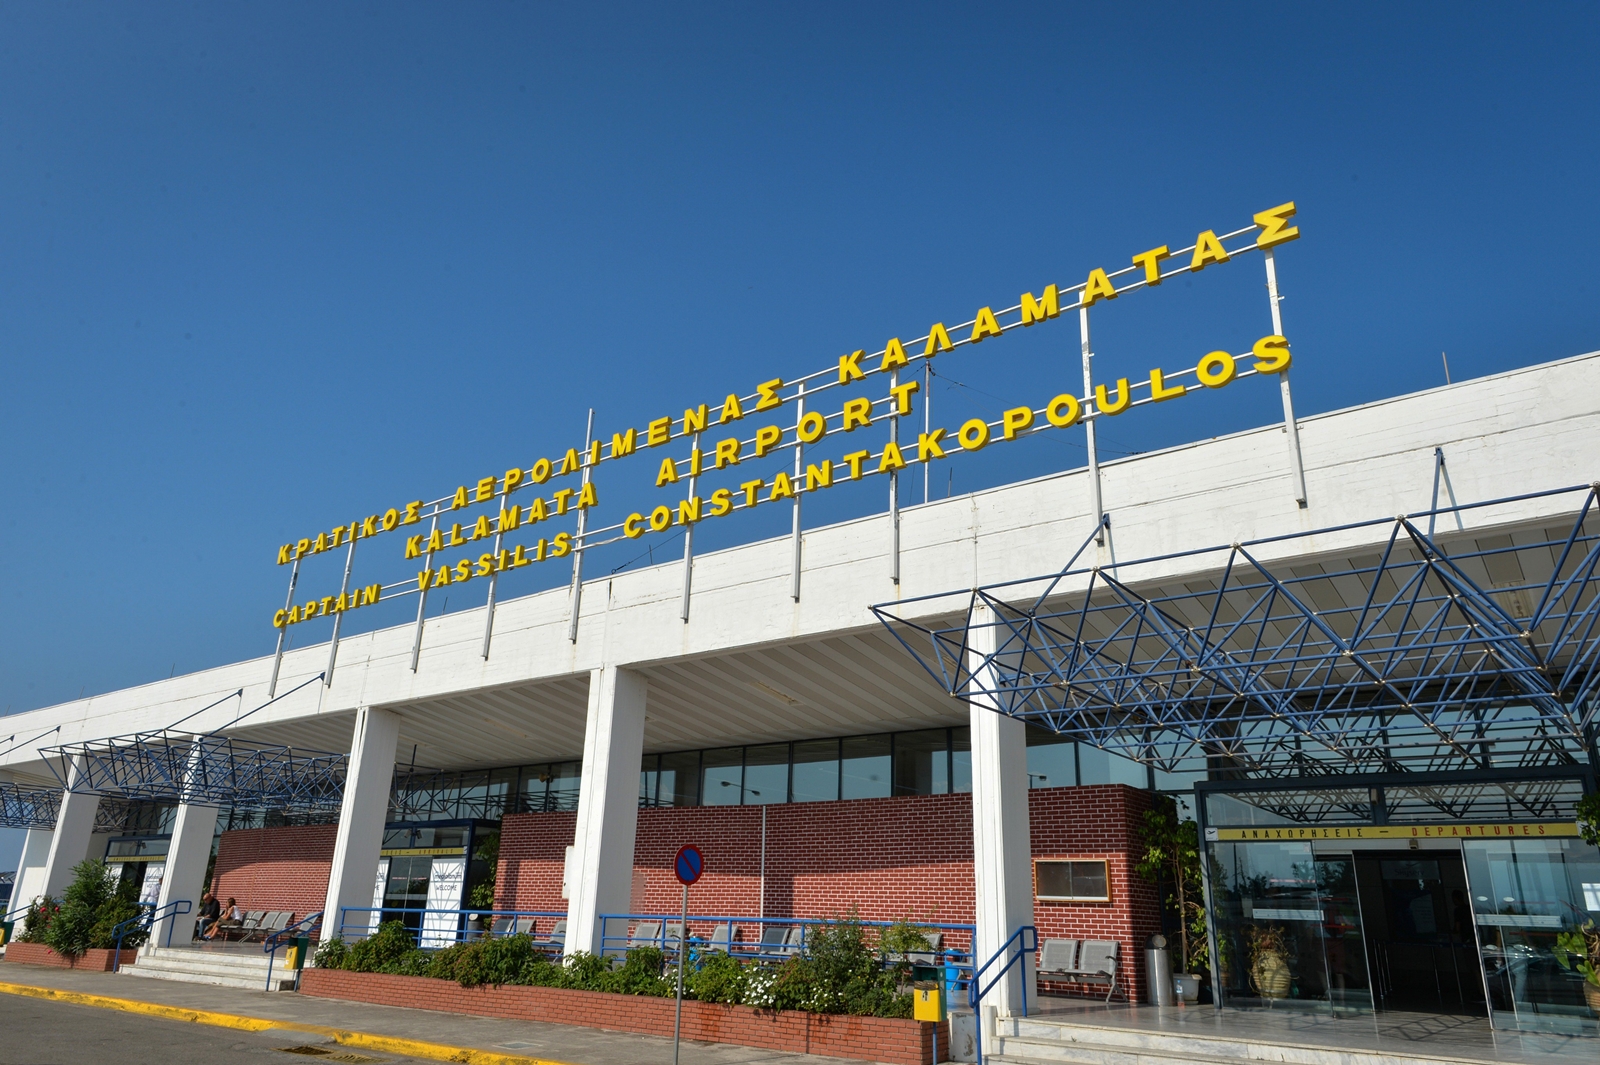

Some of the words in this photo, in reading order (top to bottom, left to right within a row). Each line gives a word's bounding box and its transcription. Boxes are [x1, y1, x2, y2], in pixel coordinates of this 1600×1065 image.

[273, 584, 379, 629] CAPTAIN
[418, 532, 574, 592] VASSILIS
[623, 335, 1293, 540] CONSTANTAKOPOULOS
[277, 501, 422, 566] ΚΡΑΤΙΚΟΣ
[451, 378, 784, 511] ΑΕΡΟΛΙΜΕΝΑΣ
[838, 202, 1300, 385] ΚΑΛΑΜΑΤΑΣ
[405, 481, 598, 560] KALAMATA
[656, 381, 919, 487] AIRPORT
[1241, 828, 1363, 839] ΑΝΑΧΩΡΗΣΕΙΣ
[1411, 825, 1546, 837] DEPARTURES
